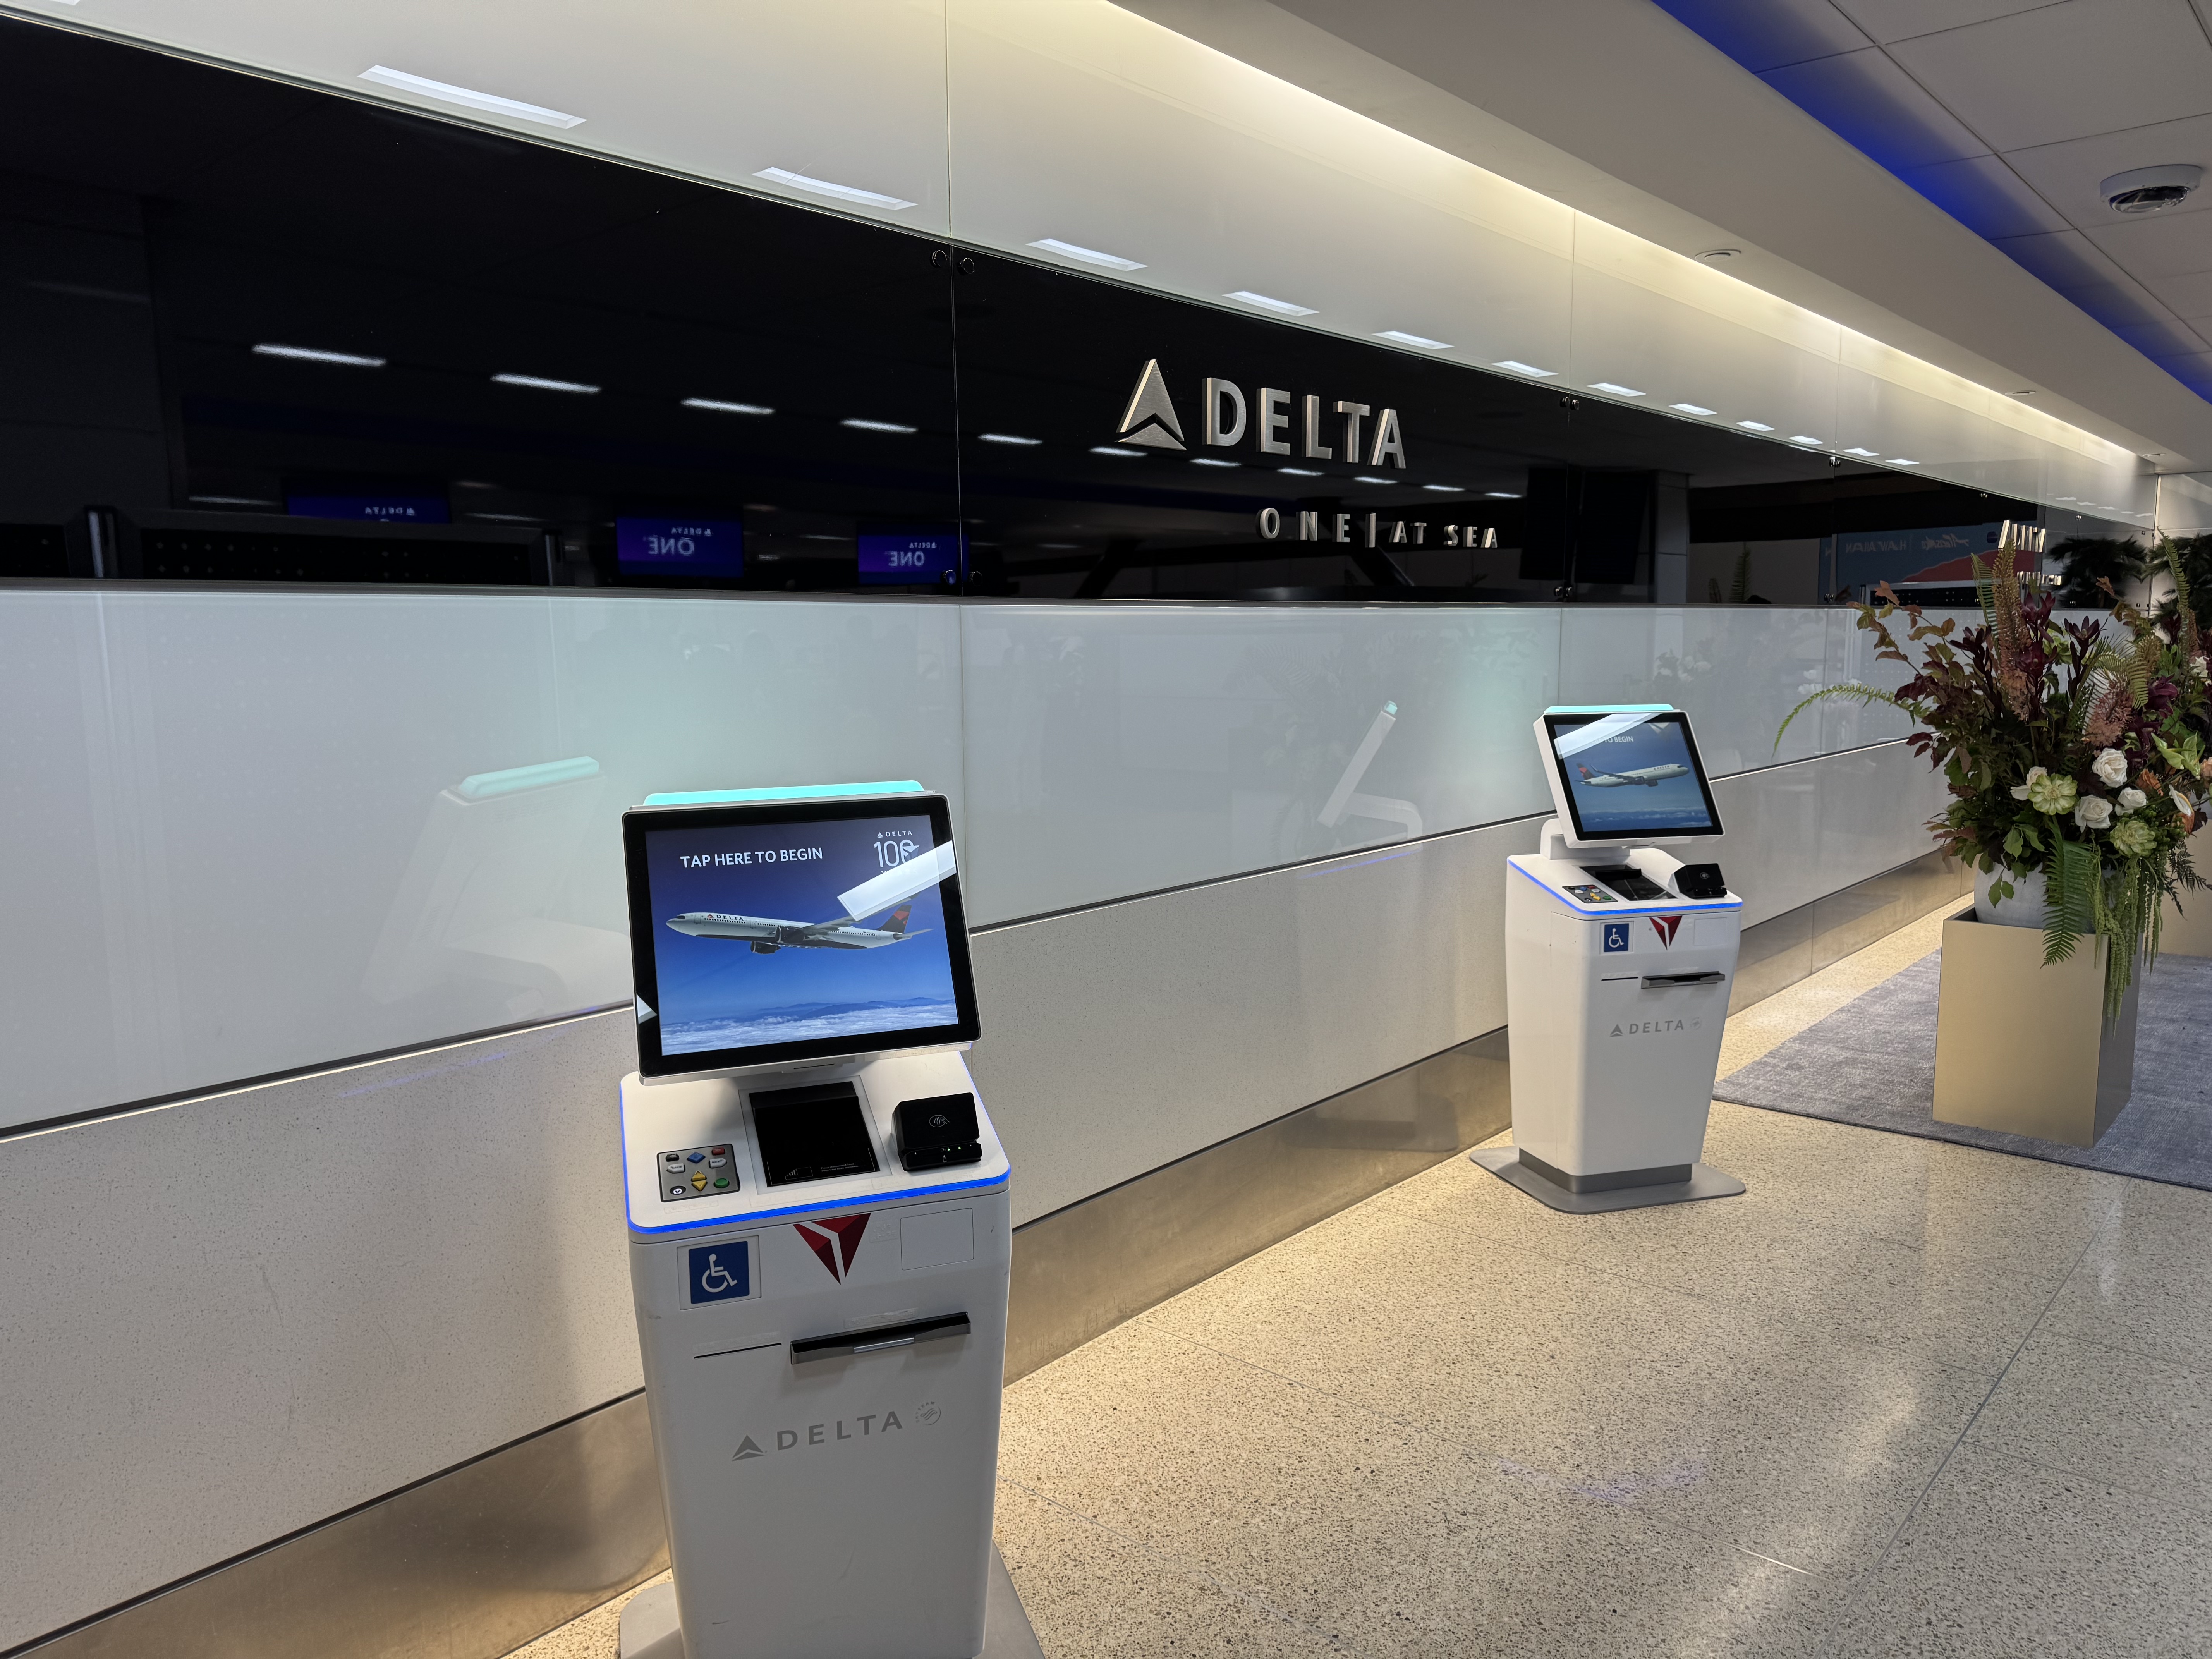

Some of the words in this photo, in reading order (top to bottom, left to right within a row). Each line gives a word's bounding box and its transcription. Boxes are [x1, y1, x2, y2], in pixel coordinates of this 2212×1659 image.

[1202, 377, 1406, 469] DELTA
[1256, 507, 1351, 543] ONE
[1388, 520, 1427, 545] AT
[1443, 524, 1498, 548] SEA
[680, 854, 711, 869] TAP
[715, 852, 752, 866] HERE
[754, 850, 776, 864] TO
[779, 847, 823, 862] BEGIN
[1629, 1020, 1684, 1034] DELTA
[777, 1410, 903, 1451] DELTA
